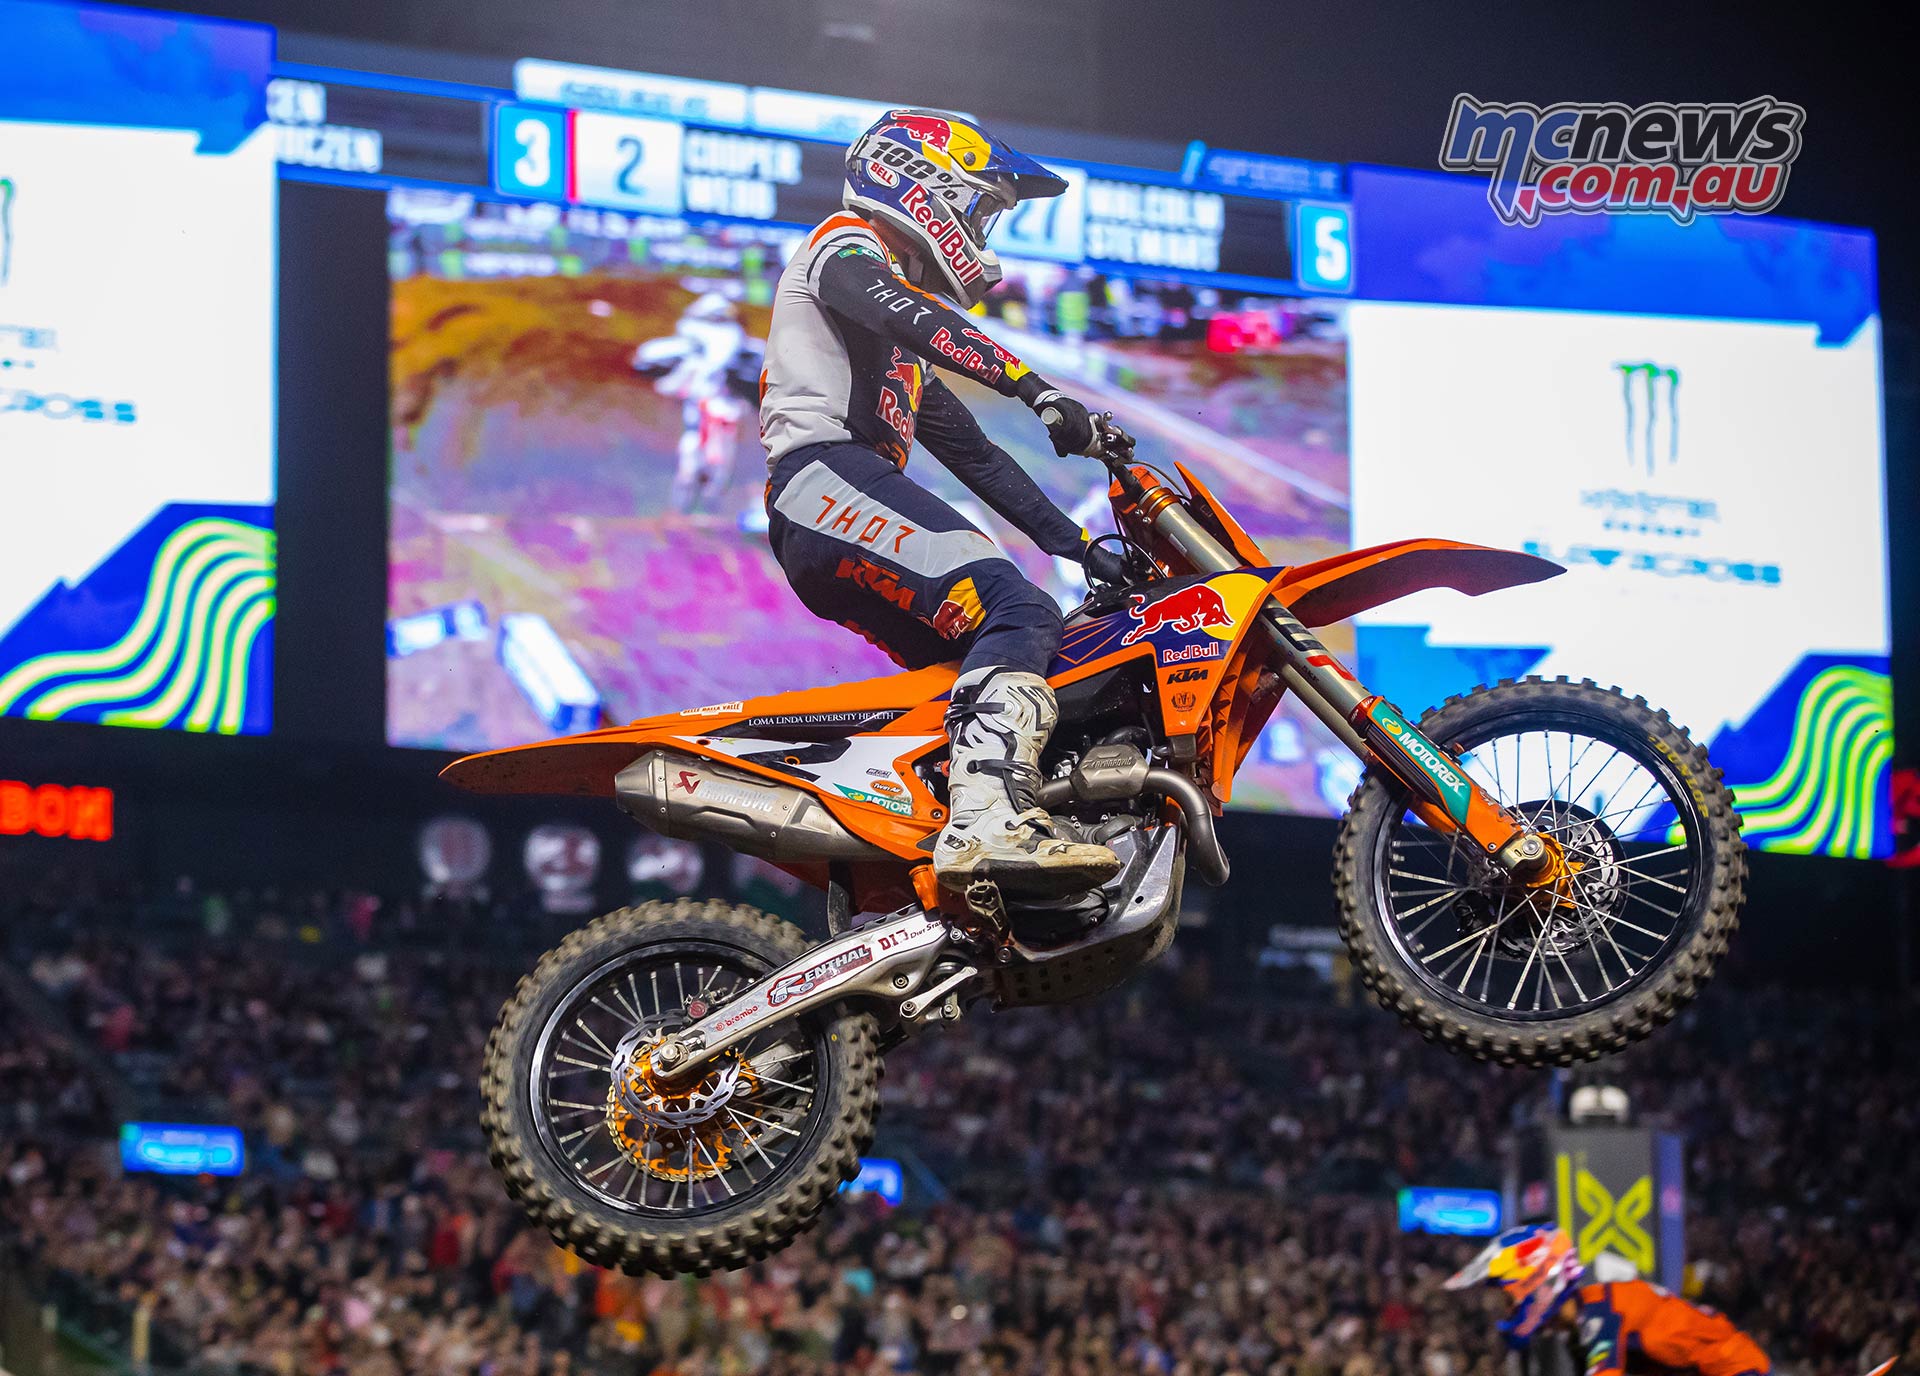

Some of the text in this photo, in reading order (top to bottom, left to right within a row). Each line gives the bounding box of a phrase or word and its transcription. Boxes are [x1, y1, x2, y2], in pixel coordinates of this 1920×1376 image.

[513, 119, 550, 187] 3
[615, 136, 645, 196] 2
[869, 162, 895, 186] BELL
[870, 140, 966, 201] 100%
[1313, 215, 1349, 282] 5
[866, 279, 933, 325] THOR
[815, 494, 916, 554] THOR
[835, 556, 916, 611] KTM
[1167, 667, 1209, 685] KTM
[748, 711, 894, 727] LOMA LINDA UNIVERSITY HEALTH
[1398, 731, 1466, 794] MOTOREX
[1654, 739, 1709, 818] DUNLOP
[768, 945, 873, 1006] RENTHAL
[725, 1005, 759, 1026] brembo
